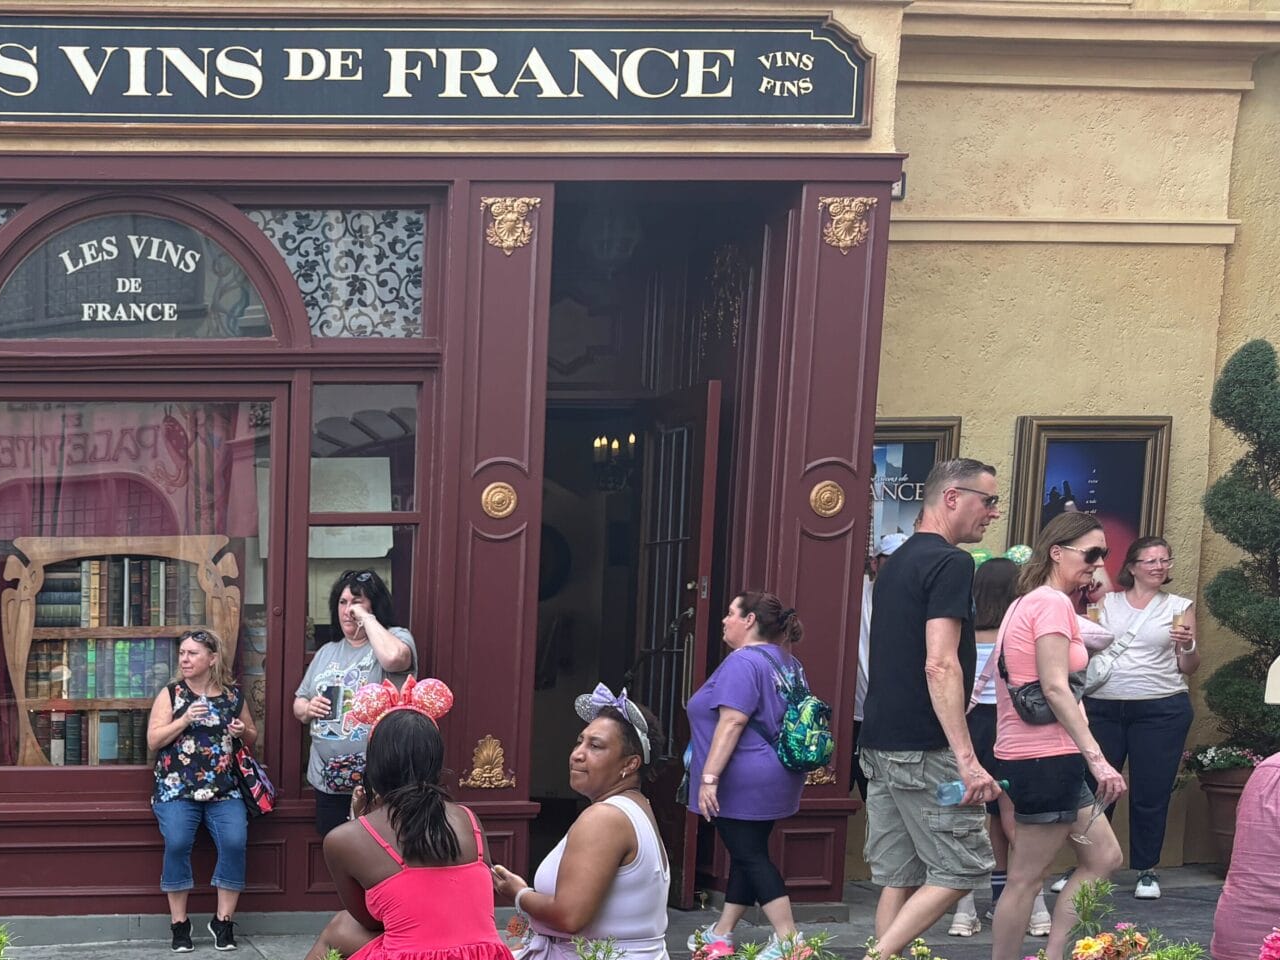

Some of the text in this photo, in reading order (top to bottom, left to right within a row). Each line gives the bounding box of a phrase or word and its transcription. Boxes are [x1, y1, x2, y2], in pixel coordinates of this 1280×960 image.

[757, 51, 815, 71] VINS
[58, 45, 264, 100] VINS
[283, 47, 363, 81] DE
[382, 47, 735, 100] FRANCE
[758, 76, 813, 97] FINS
[58, 234, 202, 275] LES VINS
[115, 277, 142, 293] DE
[81, 303, 178, 322] FRANCE
